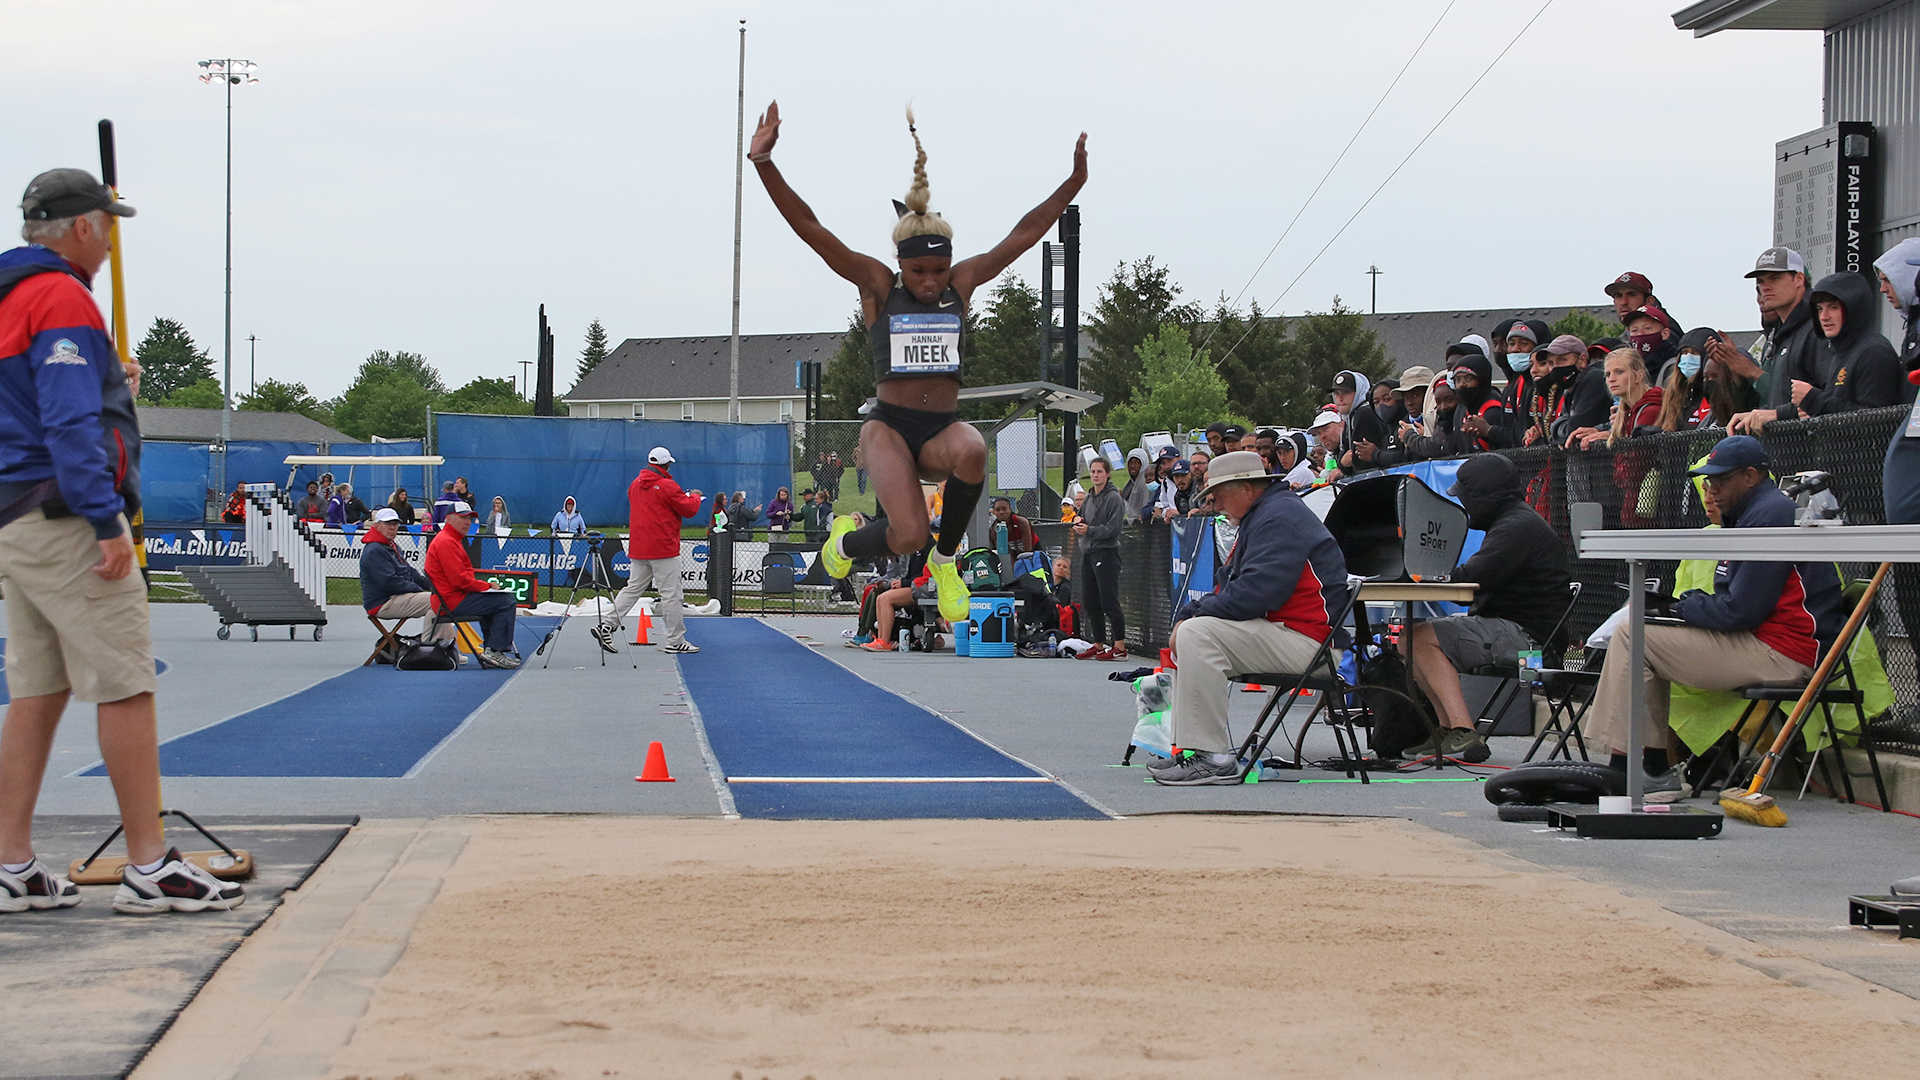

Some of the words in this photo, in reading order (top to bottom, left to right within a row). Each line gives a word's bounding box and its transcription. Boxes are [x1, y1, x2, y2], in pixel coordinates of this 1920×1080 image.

[1847, 165, 1859, 273] FAIR-PLAY.CO
[911, 335, 943, 343] HANNAH
[904, 345, 950, 363] MEEK
[1428, 521, 1442, 536] DV
